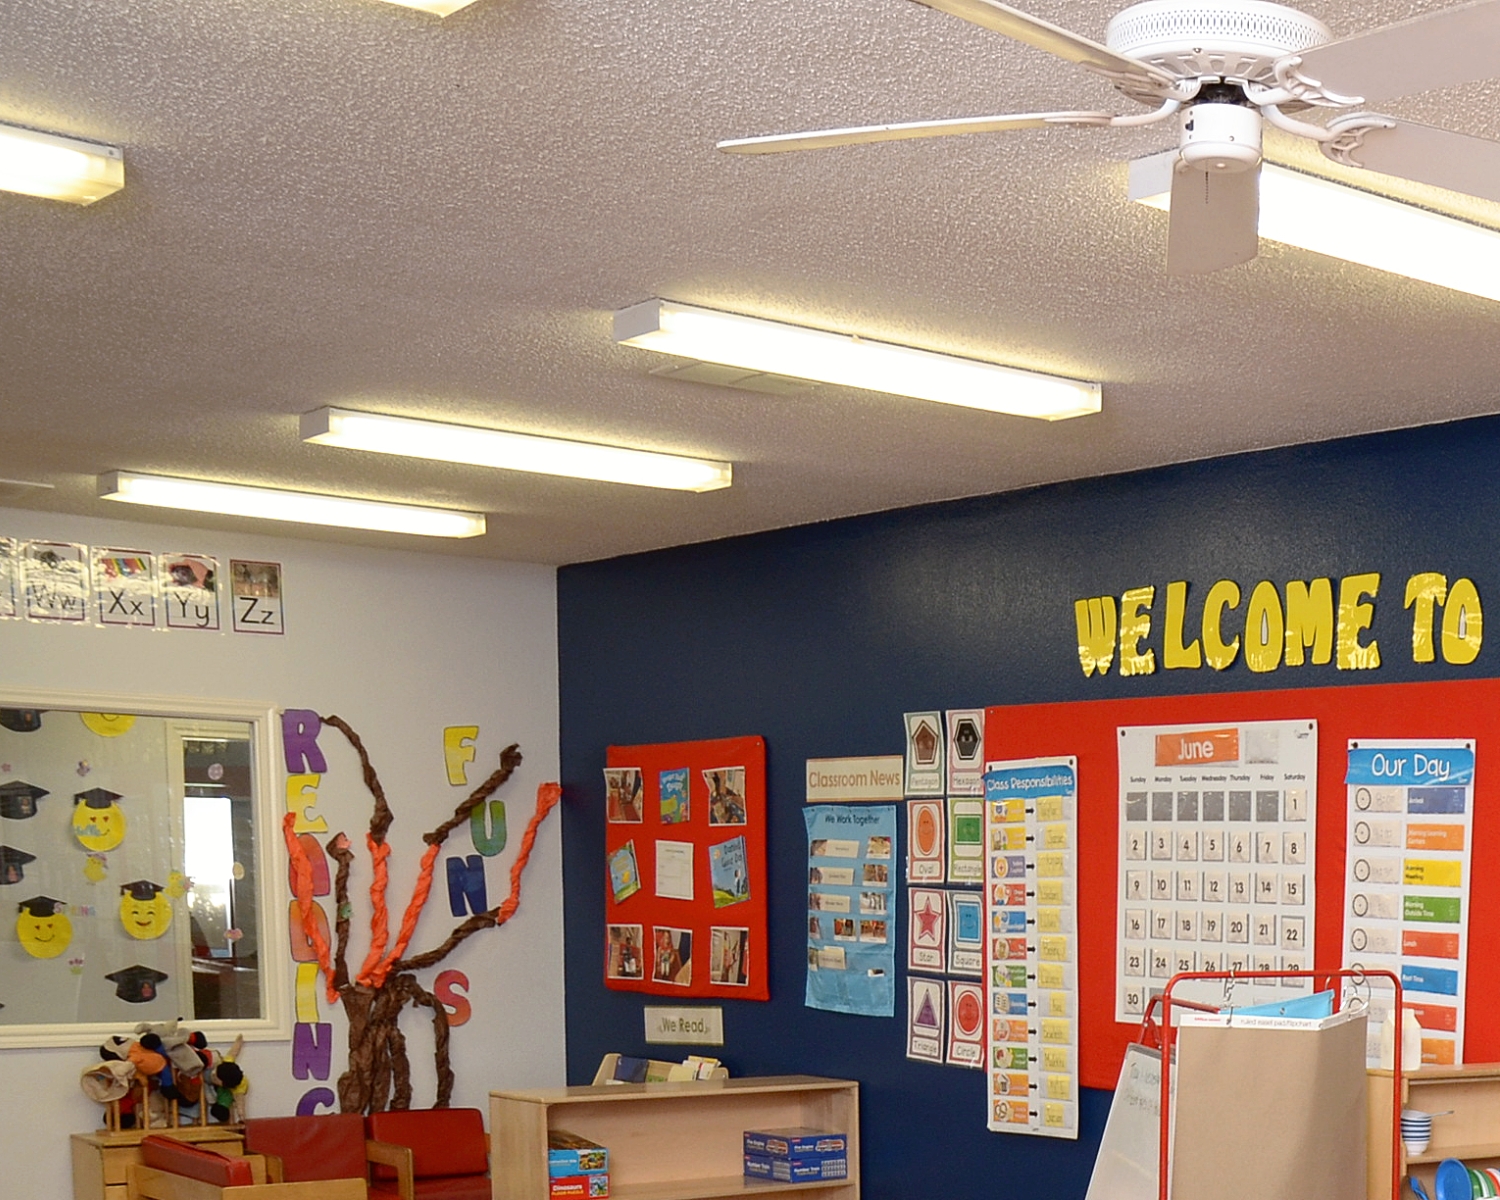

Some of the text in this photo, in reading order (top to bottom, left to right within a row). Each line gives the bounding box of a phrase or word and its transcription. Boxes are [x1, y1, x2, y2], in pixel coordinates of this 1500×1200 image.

[108, 588, 144, 616] Xx
[174, 591, 210, 627] Yy
[239, 596, 275, 625] Zz
[1074, 572, 1382, 677] WELCOME
[1404, 571, 1484, 665] TO
[1177, 739, 1214, 760] June
[1371, 753, 1451, 782] Our Day
[808, 769, 900, 788] Classroom News
[986, 773, 1073, 791] Class Responsibilities
[1130, 776, 1146, 784] Sunday
[1179, 775, 1197, 783] Tuesday
[1201, 774, 1227, 783] Wednesday
[1229, 774, 1250, 782] Thursday
[1259, 774, 1274, 782] Friday
[1283, 773, 1306, 782] Saturday
[1292, 798, 1297, 810] 1
[825, 814, 880, 825] We Work Together
[1132, 838, 1297, 854] 2 3 4 5 6 7 8
[918, 865, 934, 874] Oval
[1134, 879, 1297, 895] 9 10 11 12 13 14 15
[1131, 918, 1298, 940] 16 17 18 19 20 21 22
[918, 951, 935, 962] Star
[955, 953, 981, 967] Square
[1129, 956, 1139, 967] 23
[1155, 957, 1166, 968] 24
[1178, 959, 1189, 971] 25
[1204, 961, 1215, 971] 26
[1232, 961, 1242, 971] 27
[1127, 993, 1138, 1005] 30
[661, 1016, 705, 1033] We Read
[913, 1040, 937, 1055] Triangle
[956, 1045, 976, 1058] Circle
